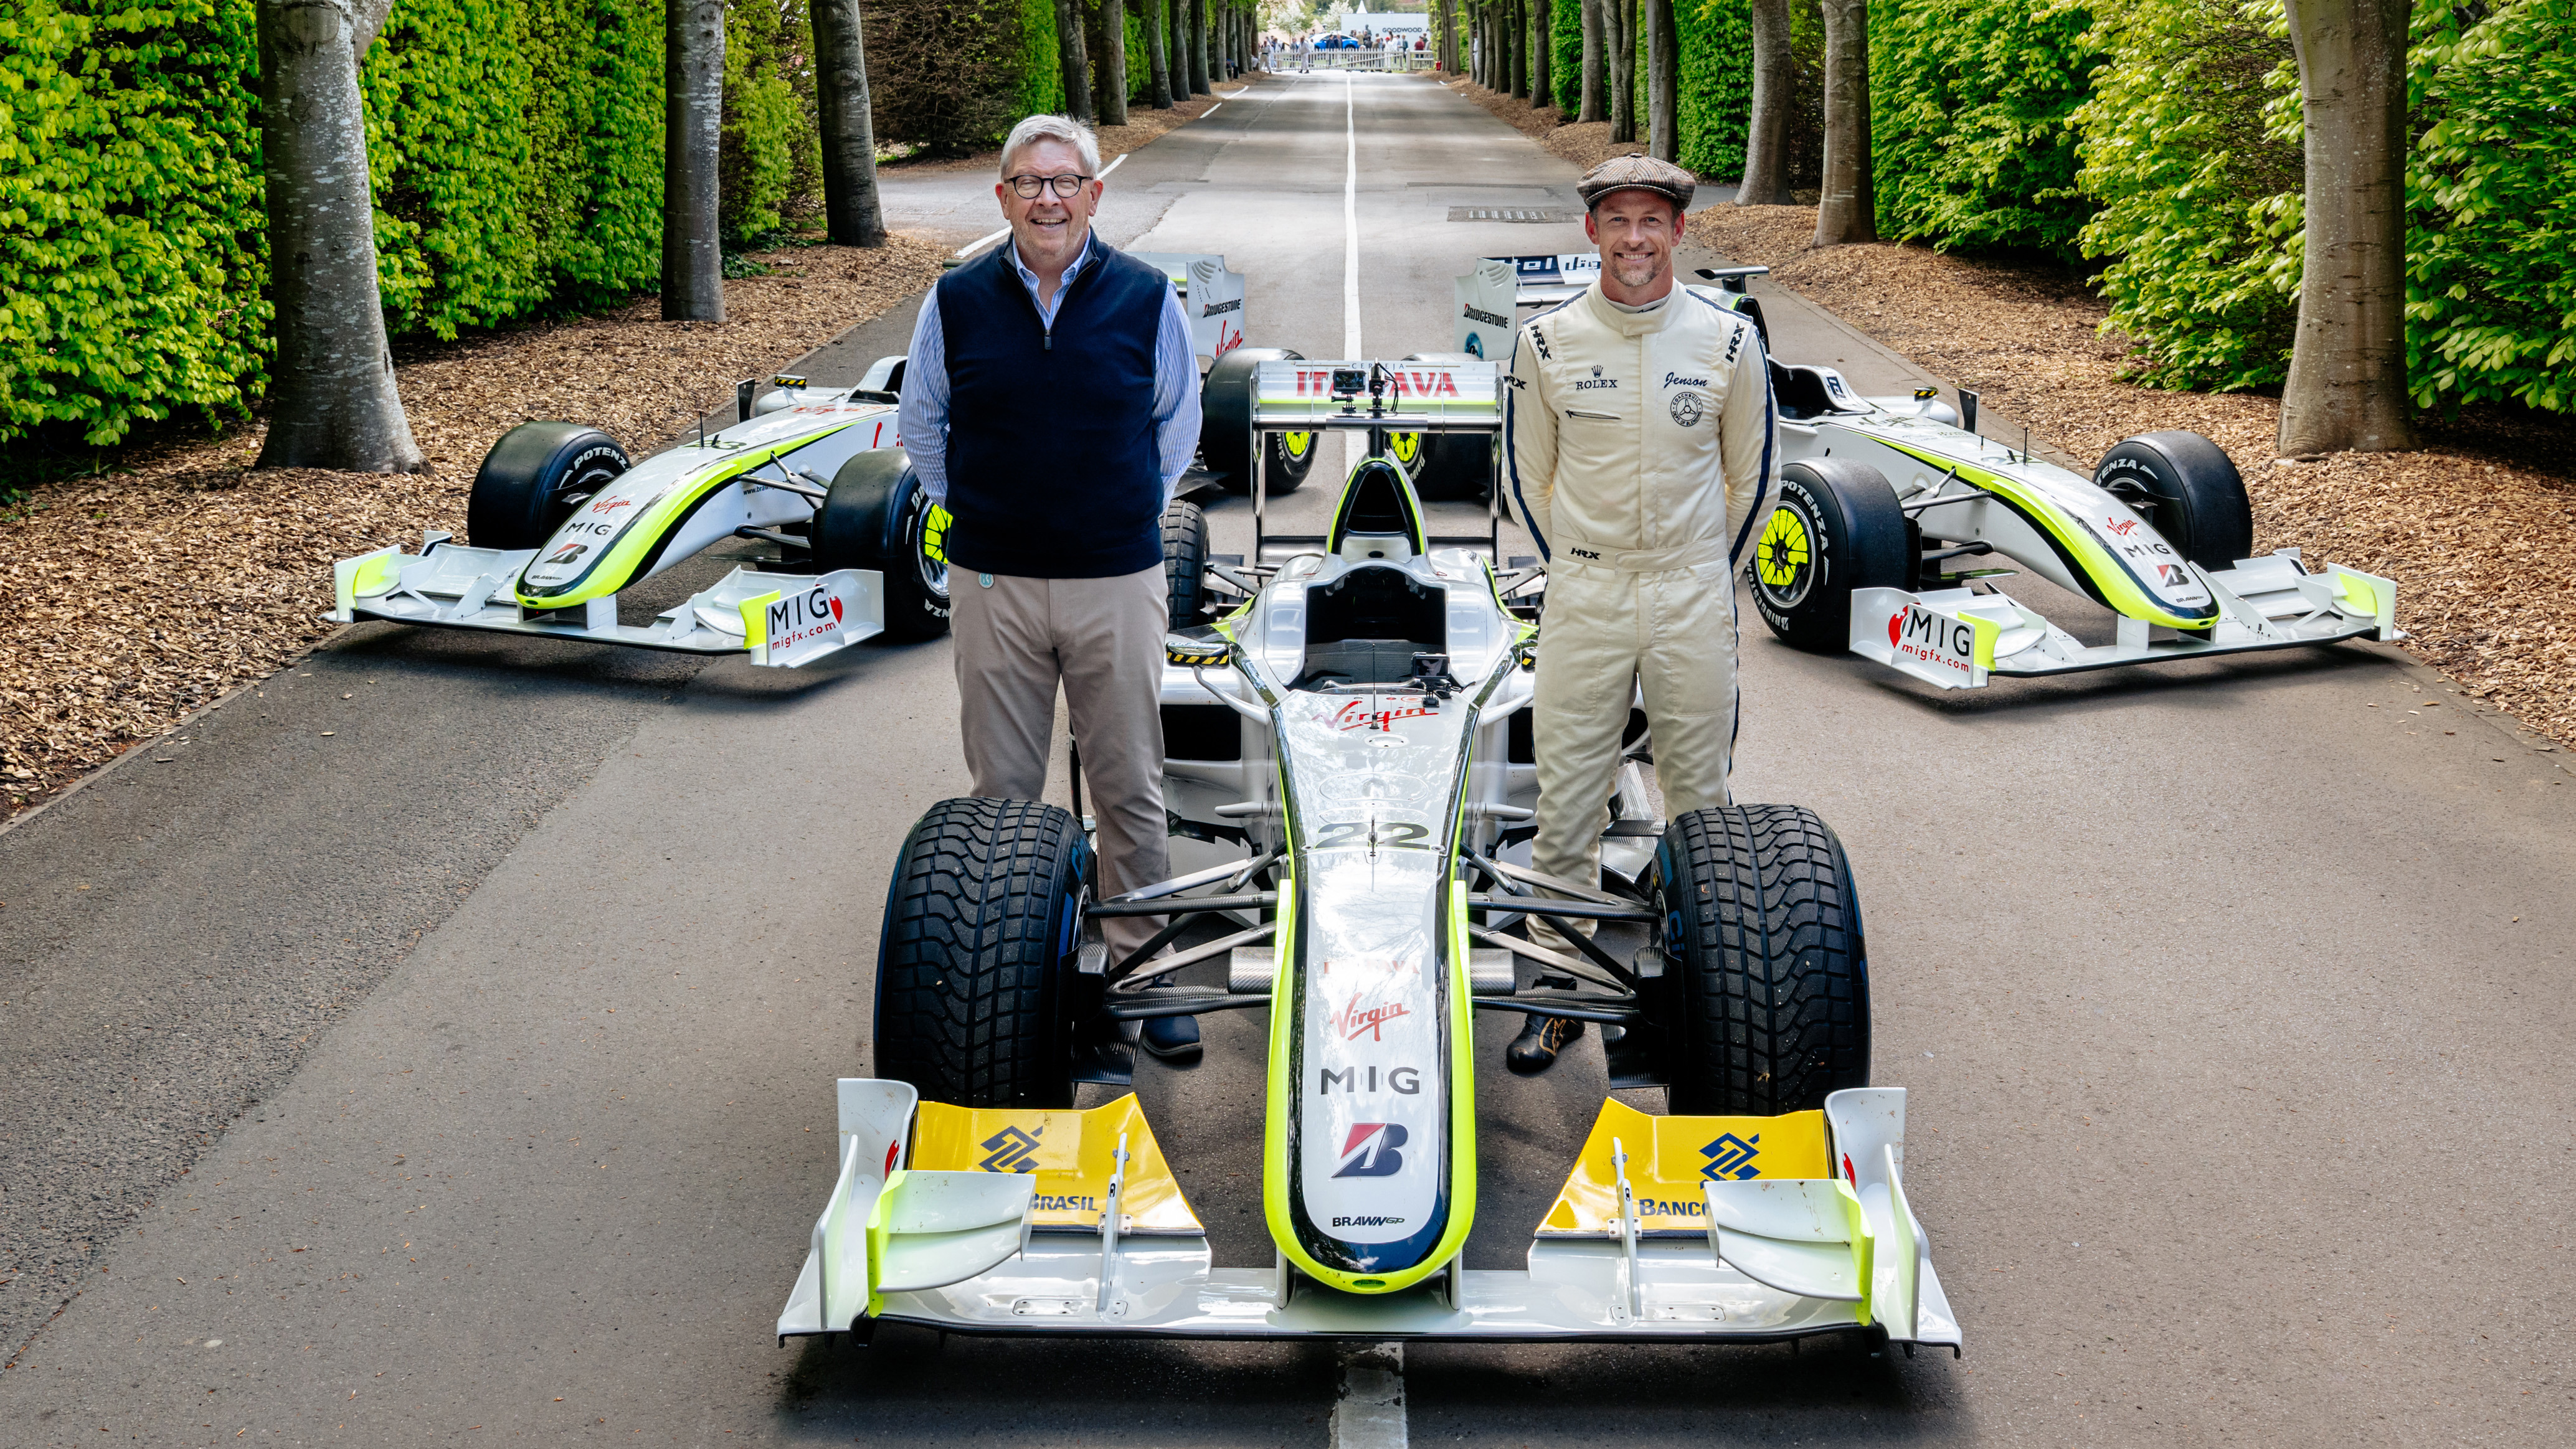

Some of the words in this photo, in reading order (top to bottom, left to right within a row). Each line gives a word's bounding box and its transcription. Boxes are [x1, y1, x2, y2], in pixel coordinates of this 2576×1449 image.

[1203, 299, 1241, 318] BRIDGESTONE
[1464, 303, 1508, 329] BRIDGESTONE
[1530, 325, 1552, 361] HRX
[1725, 322, 1745, 363] HRX
[1352, 363, 1404, 371] CEREJA
[1664, 372, 1707, 389] Jenson
[1296, 371, 1461, 397] ITAVA
[1576, 380, 1618, 390] ROLEX
[1673, 394, 1701, 405] COACHBUILT
[574, 446, 631, 472] POTENZ
[2095, 458, 2137, 486] TENZA
[564, 522, 612, 535] MIG
[1781, 480, 1829, 551] POTENZA
[2106, 517, 2138, 536] Virgin
[1571, 547, 1601, 560] HRX
[2124, 544, 2171, 557] MIG
[1746, 563, 1789, 631] BRIDGESTON
[771, 588, 830, 635] MIG
[772, 622, 836, 650] migfx.com
[1907, 608, 1970, 656] MIG
[1901, 644, 1969, 673] migfx.com
[1312, 701, 1439, 732] Virgin
[1315, 823, 1430, 850] 22
[1329, 992, 1411, 1041] Virgin
[1321, 1066, 1419, 1095] MIG
